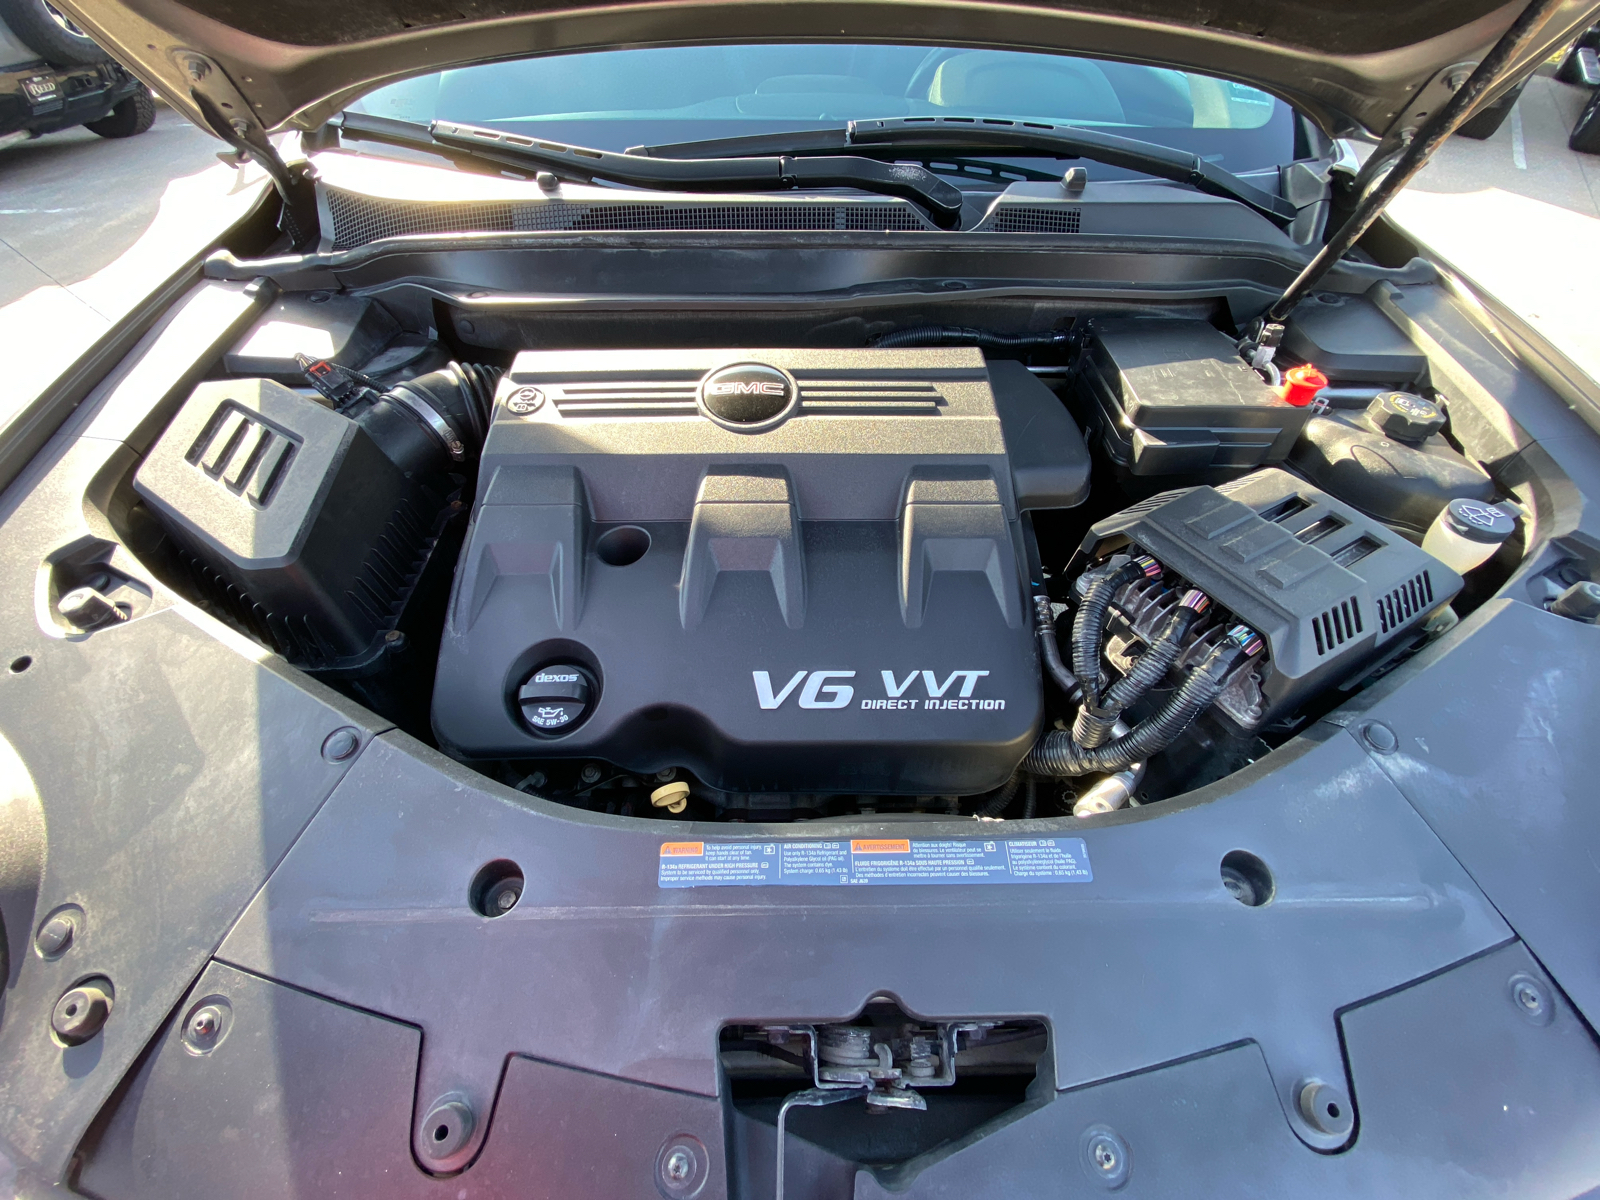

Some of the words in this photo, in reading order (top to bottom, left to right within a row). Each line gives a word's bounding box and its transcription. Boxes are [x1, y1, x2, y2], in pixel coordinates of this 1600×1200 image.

[711, 382, 784, 397] GMC
[535, 673, 580, 683] dexos
[881, 670, 990, 698] VVT
[752, 671, 856, 710] V6
[861, 699, 918, 710] DIRECT
[924, 699, 1006, 710] INJECTION
[532, 715, 545, 725] SAE
[545, 714, 569, 726] 5W-30
